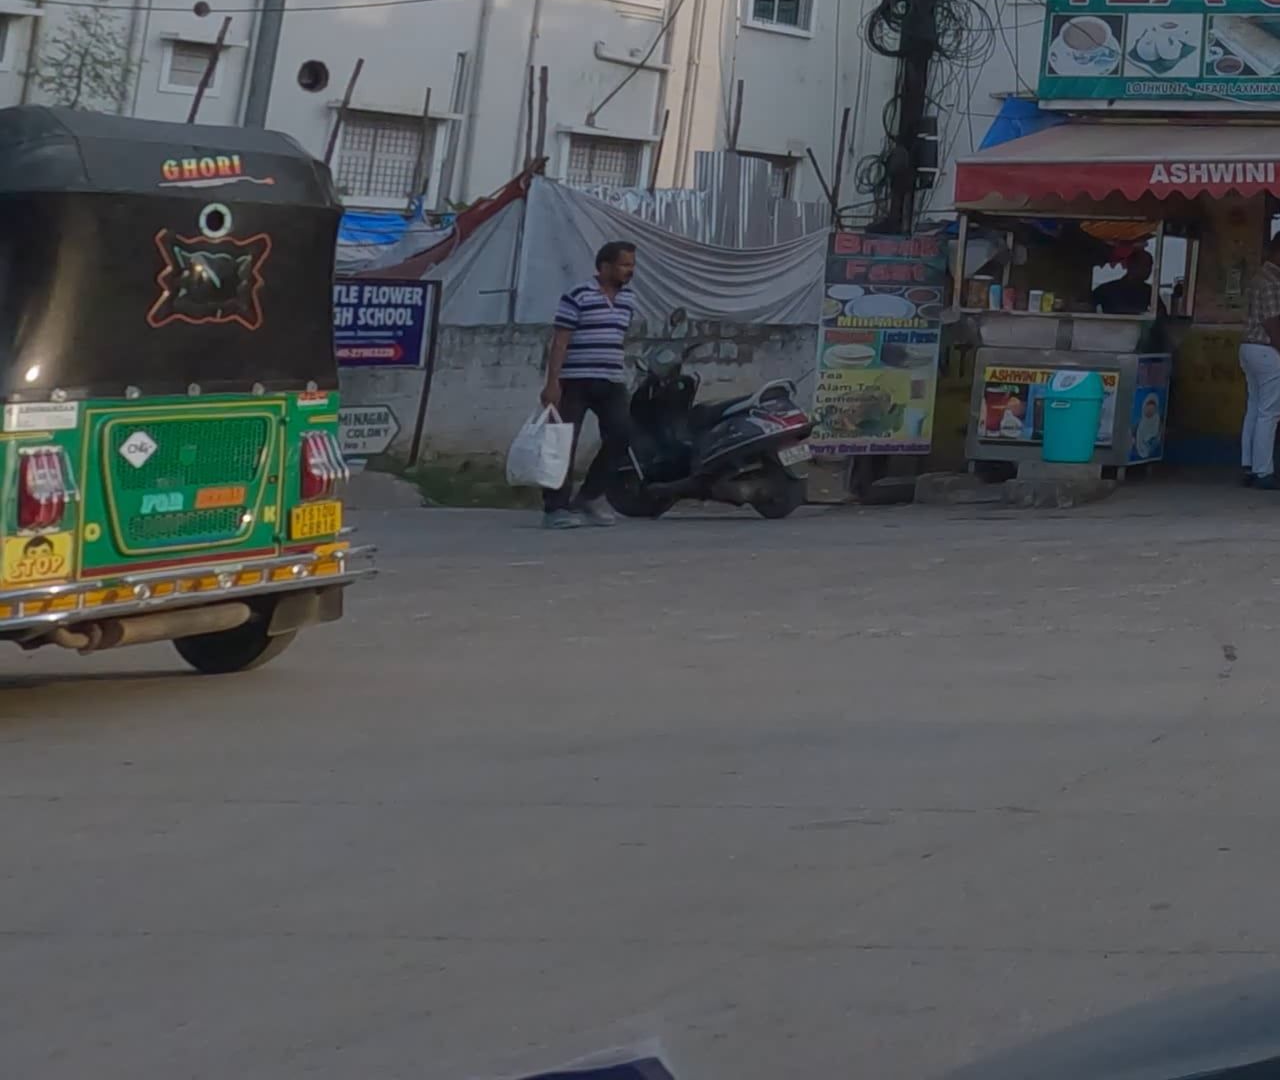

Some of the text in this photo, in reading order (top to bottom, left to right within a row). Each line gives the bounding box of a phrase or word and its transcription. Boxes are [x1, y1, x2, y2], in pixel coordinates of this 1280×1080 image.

[1196, 82, 1227, 96] NEAR
[162, 154, 242, 181] GHORI
[1150, 161, 1275, 184] ASHWINI
[834, 232, 940, 257] Break
[846, 260, 926, 281] Fast
[362, 285, 423, 306] FLOWER
[357, 307, 414, 327] SCHOOL
[819, 371, 842, 380] Tea
[989, 369, 1037, 383] ASHWINI
[346, 428, 390, 439] COLONY
[808, 443, 836, 454] Party
[838, 443, 868, 453] Order
[10, 556, 64, 579] STOP
